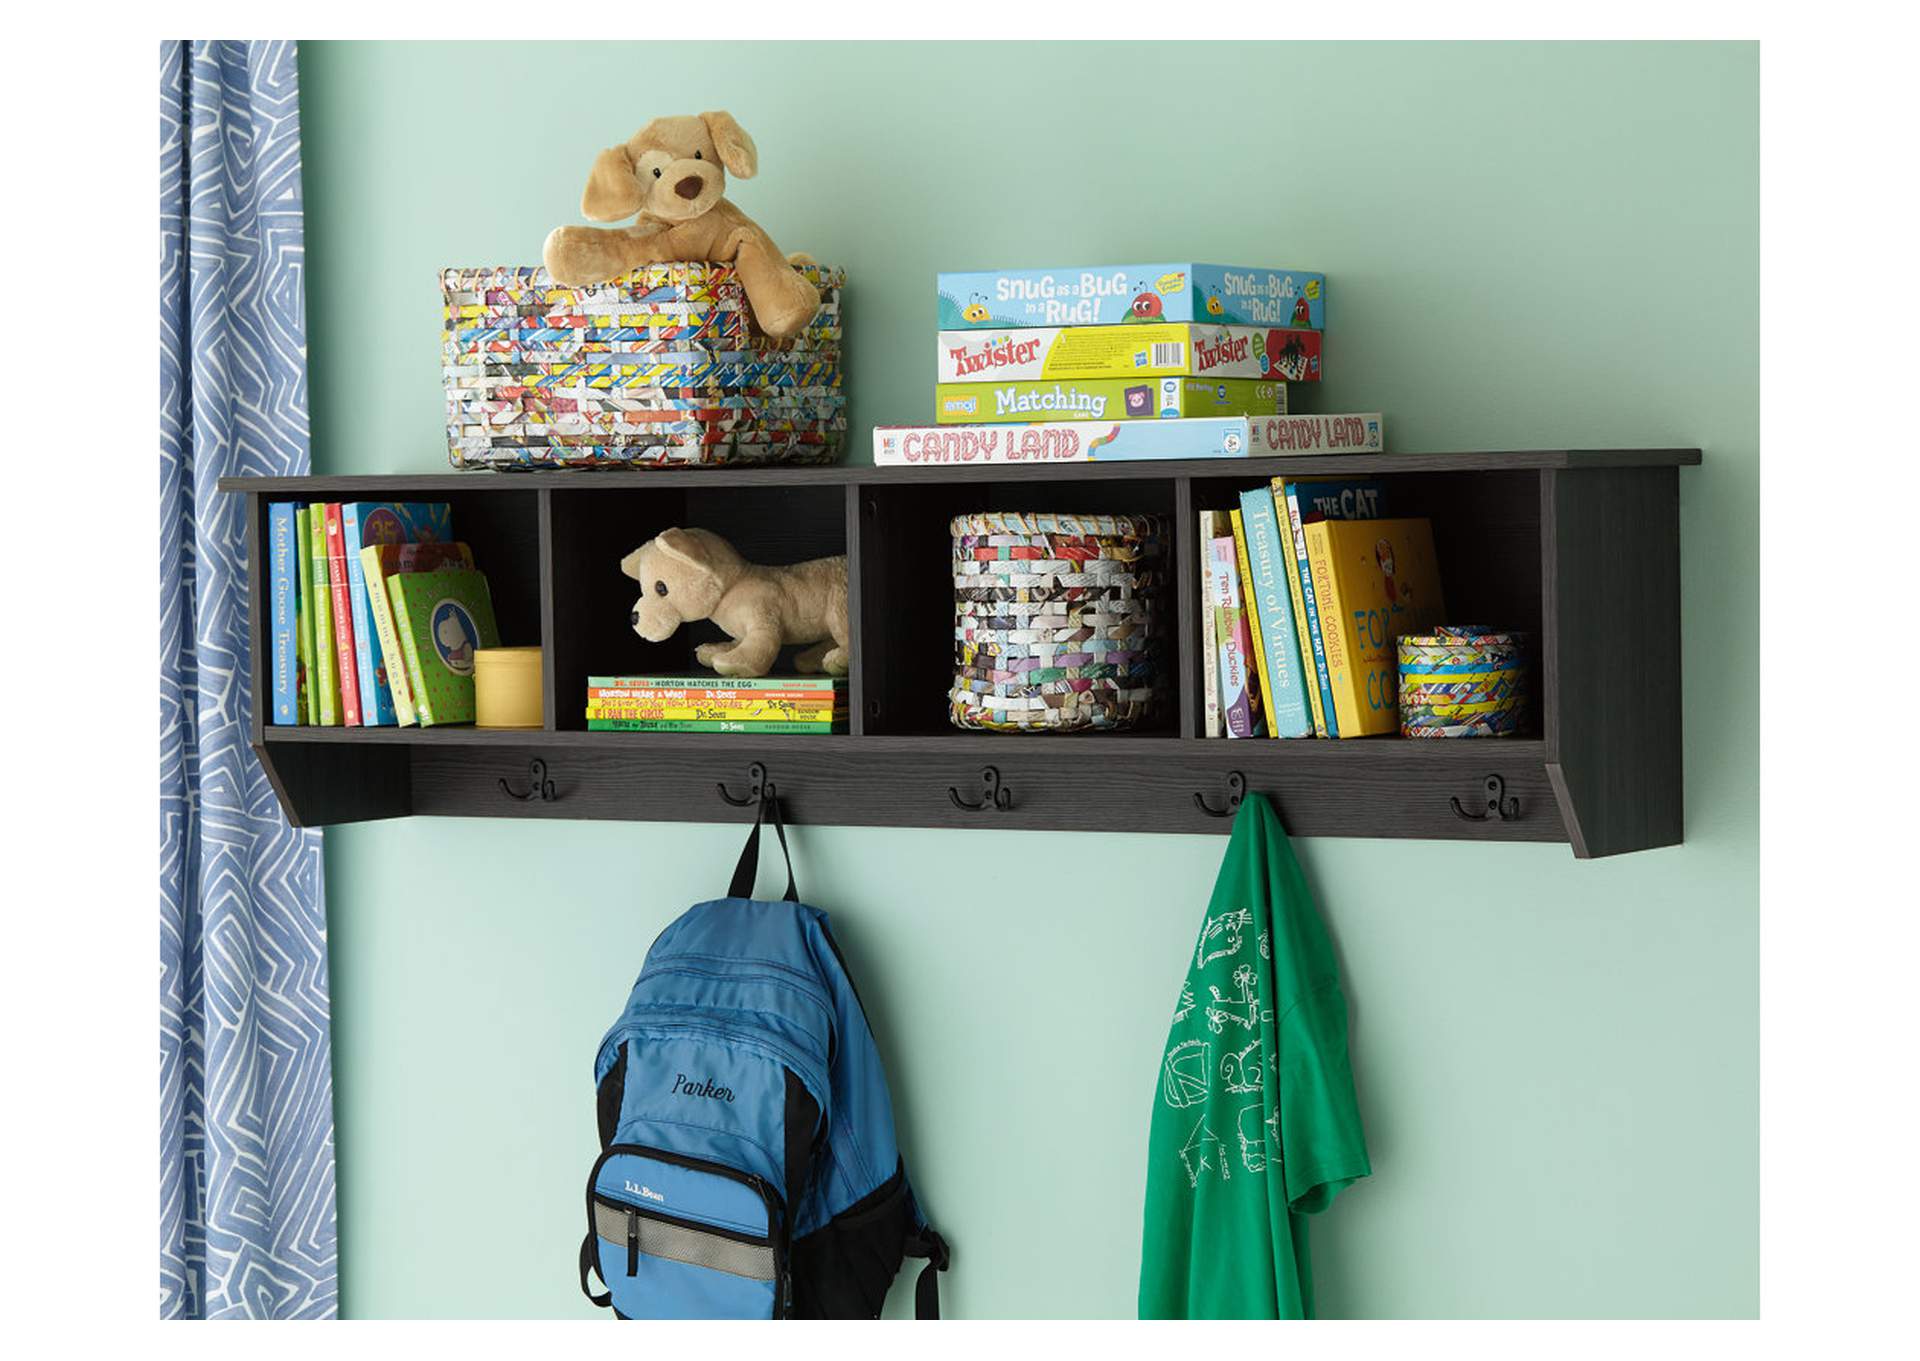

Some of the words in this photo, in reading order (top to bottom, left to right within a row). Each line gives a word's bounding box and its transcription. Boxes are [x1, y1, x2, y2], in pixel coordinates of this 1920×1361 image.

[950, 338, 1041, 377] Twister
[1194, 335, 1248, 373] Twister
[994, 385, 1108, 418] Matching
[902, 429, 998, 463] CANDY
[1006, 428, 1080, 461] LAND
[1266, 418, 1322, 450] CANDY
[1324, 417, 1366, 448] LAND
[1314, 496, 1339, 517] THE
[1340, 488, 1379, 519] CAT
[276, 517, 289, 574] Mother
[1253, 504, 1275, 588] Treasury
[1218, 572, 1229, 597] Ten
[1300, 566, 1310, 584] THE
[278, 577, 290, 625] Goose
[1263, 592, 1279, 616] of
[1304, 587, 1314, 604] CAT
[1220, 598, 1233, 641] Rubber
[1313, 559, 1334, 613] FORTUNE
[1325, 615, 1343, 668] COOKIES
[279, 631, 291, 695] Treasury
[1269, 613, 1291, 689] Virtues
[1312, 637, 1323, 657] HAT
[1226, 642, 1239, 687] Duckies
[655, 680, 685, 688] HORTON
[687, 679, 719, 688] HATCHES
[721, 679, 738, 688] THE
[739, 679, 752, 689] EGG
[639, 709, 665, 719] CIRCUS
[708, 709, 727, 720] Seuss
[671, 1073, 736, 1103] Parker
[625, 1180, 665, 1203] L.L.Bean
